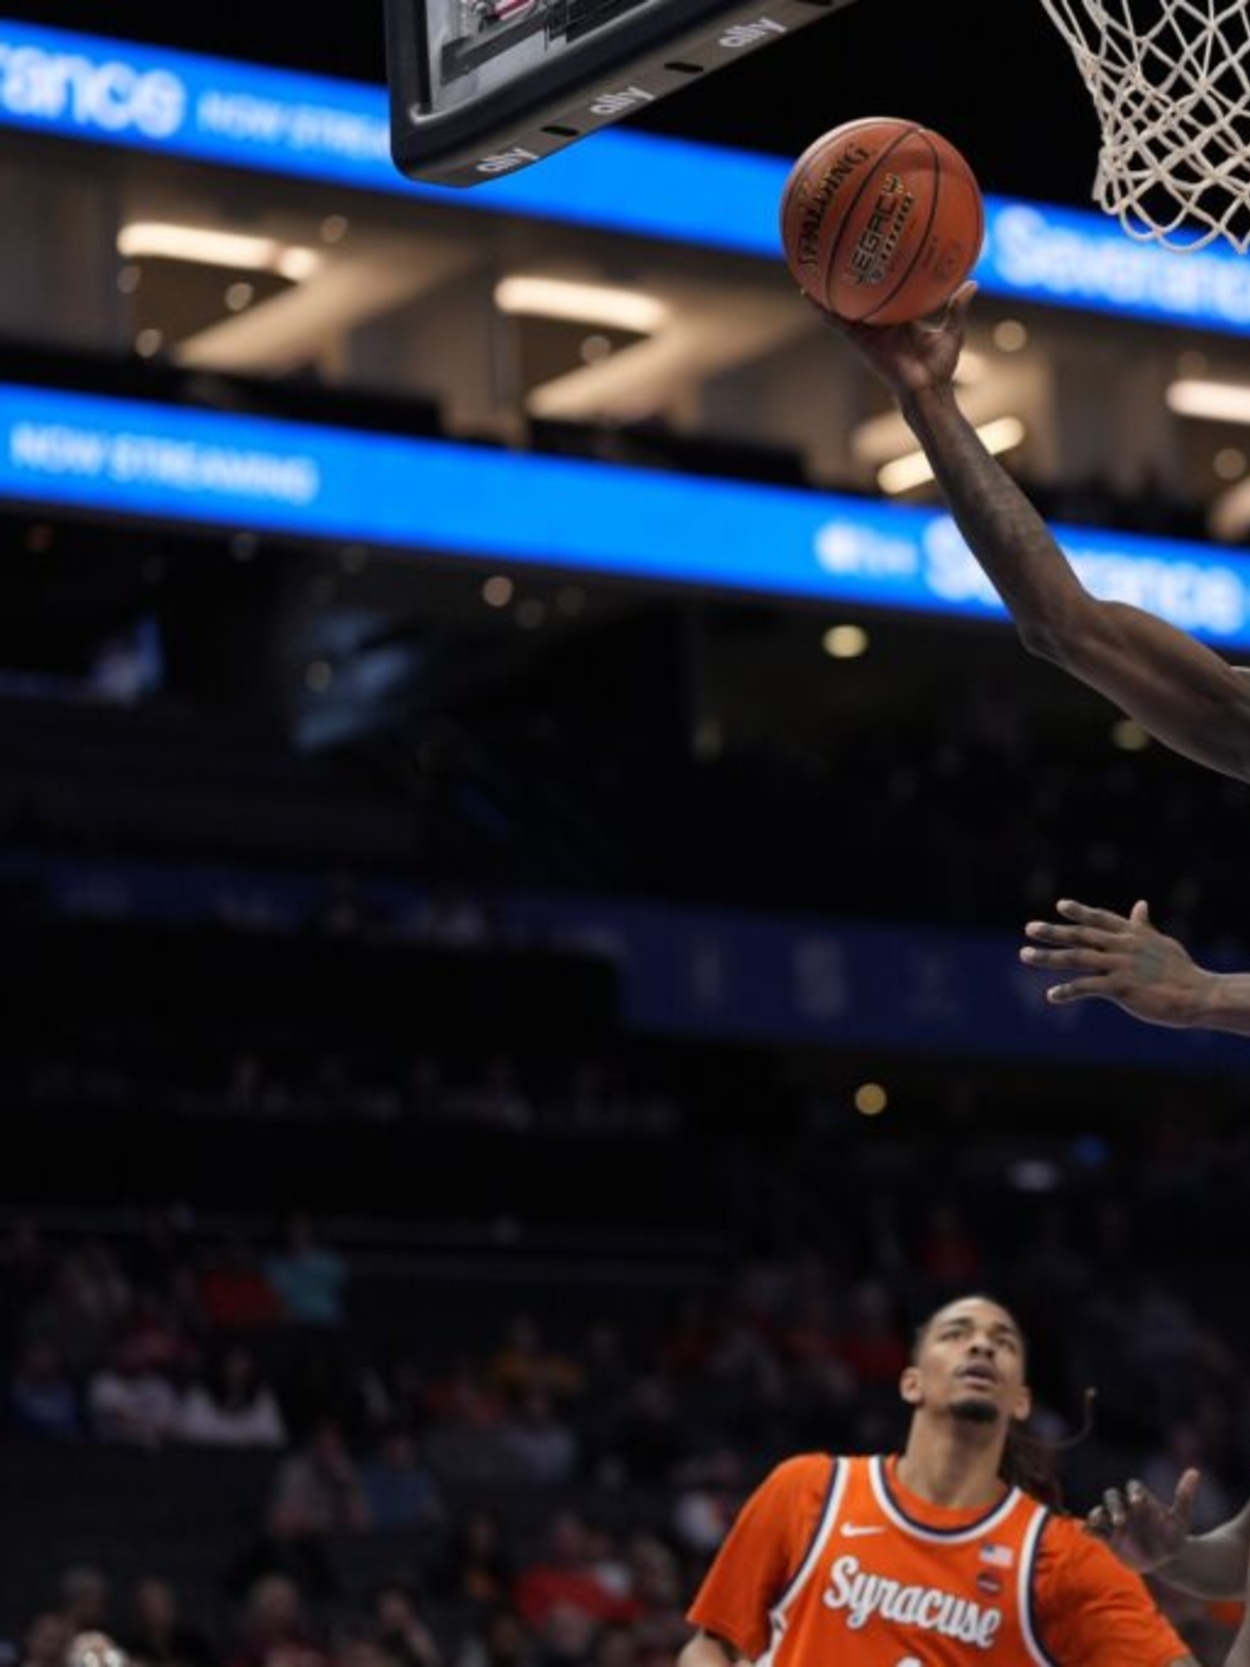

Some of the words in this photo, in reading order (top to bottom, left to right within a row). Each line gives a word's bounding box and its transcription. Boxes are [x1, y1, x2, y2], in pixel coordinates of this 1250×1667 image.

[718, 16, 787, 49] ally
[590, 85, 656, 115] ally
[477, 146, 540, 174] ally
[823, 1556, 1002, 1650] Syracuse
